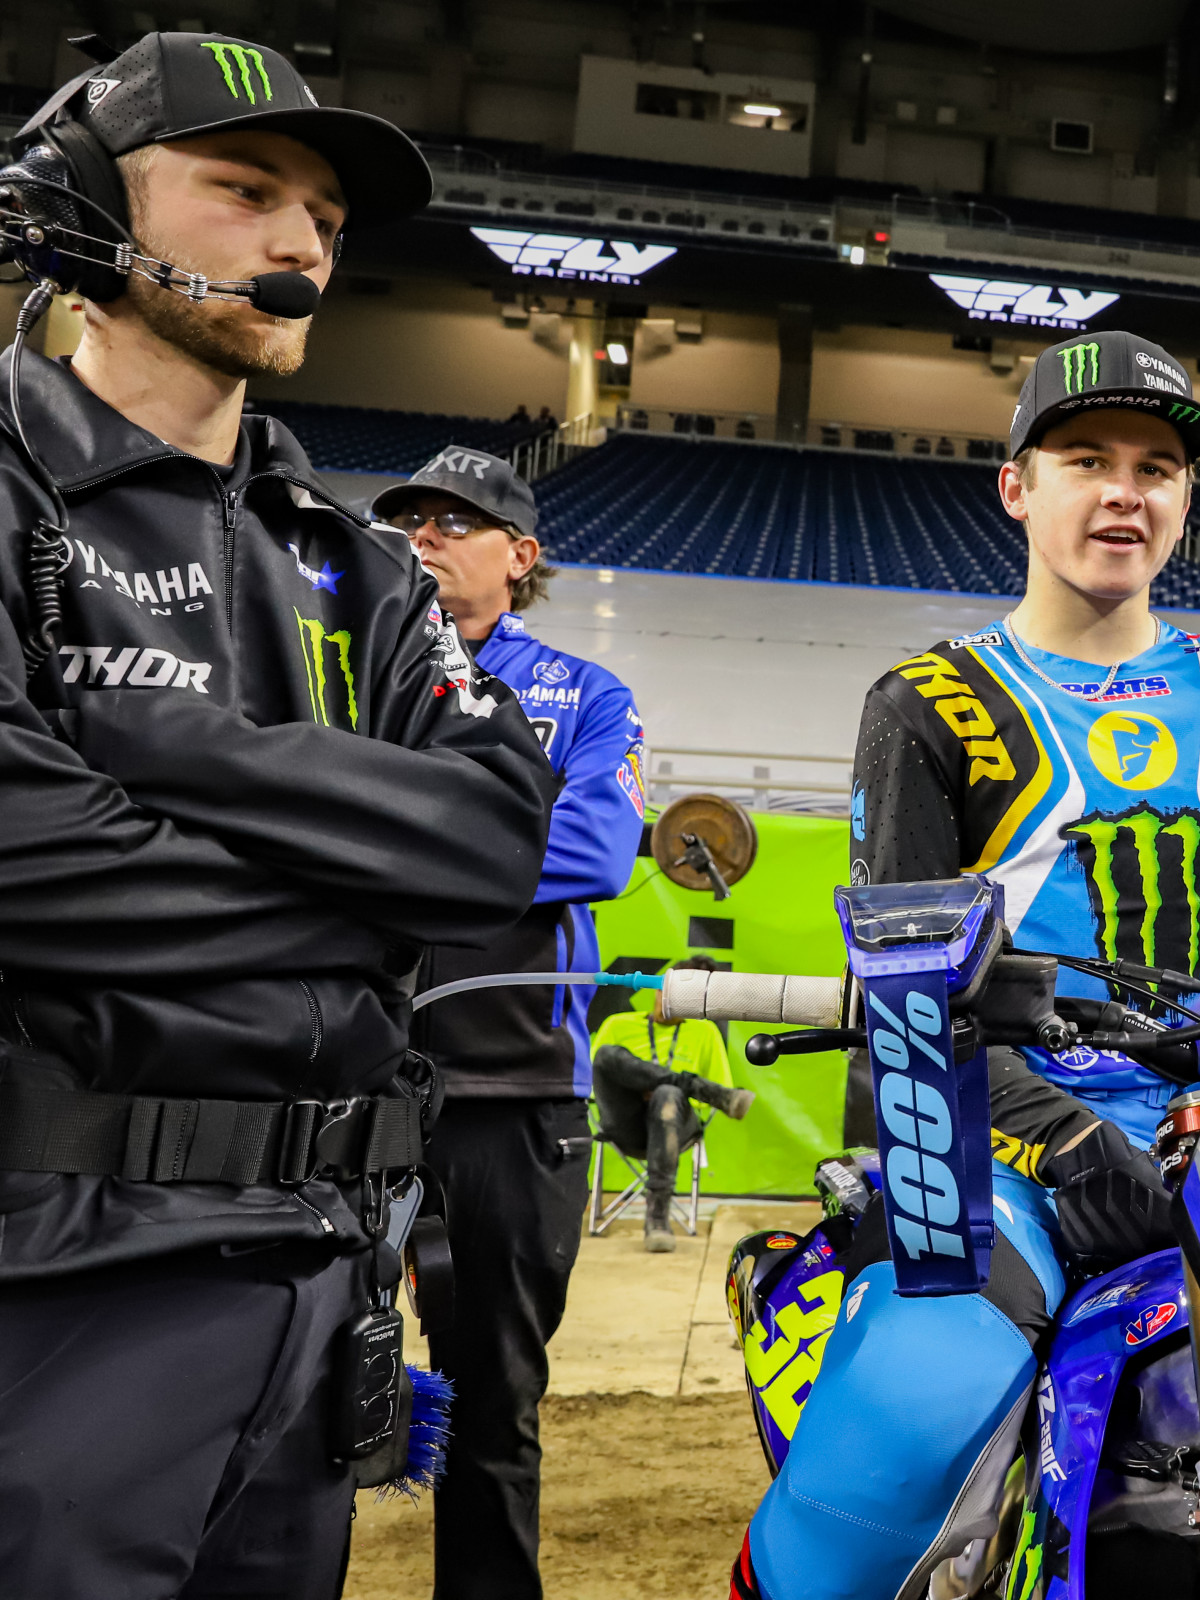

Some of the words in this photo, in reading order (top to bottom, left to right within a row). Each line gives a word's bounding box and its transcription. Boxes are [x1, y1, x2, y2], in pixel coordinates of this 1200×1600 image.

[470, 227, 678, 276] FLY
[512, 263, 632, 285] RACING
[929, 274, 1120, 320] FLY
[968, 309, 1079, 330] RACING
[1150, 357, 1187, 391] YAMAHA
[1083, 395, 1161, 406] YAMAHA
[74, 538, 214, 604] YAMAHA
[58, 645, 213, 694] THOR
[1060, 676, 1168, 699] PARTS
[889, 652, 1017, 787] THOR
[868, 990, 967, 1260] 100%
[1126, 1304, 1160, 1342] VP
